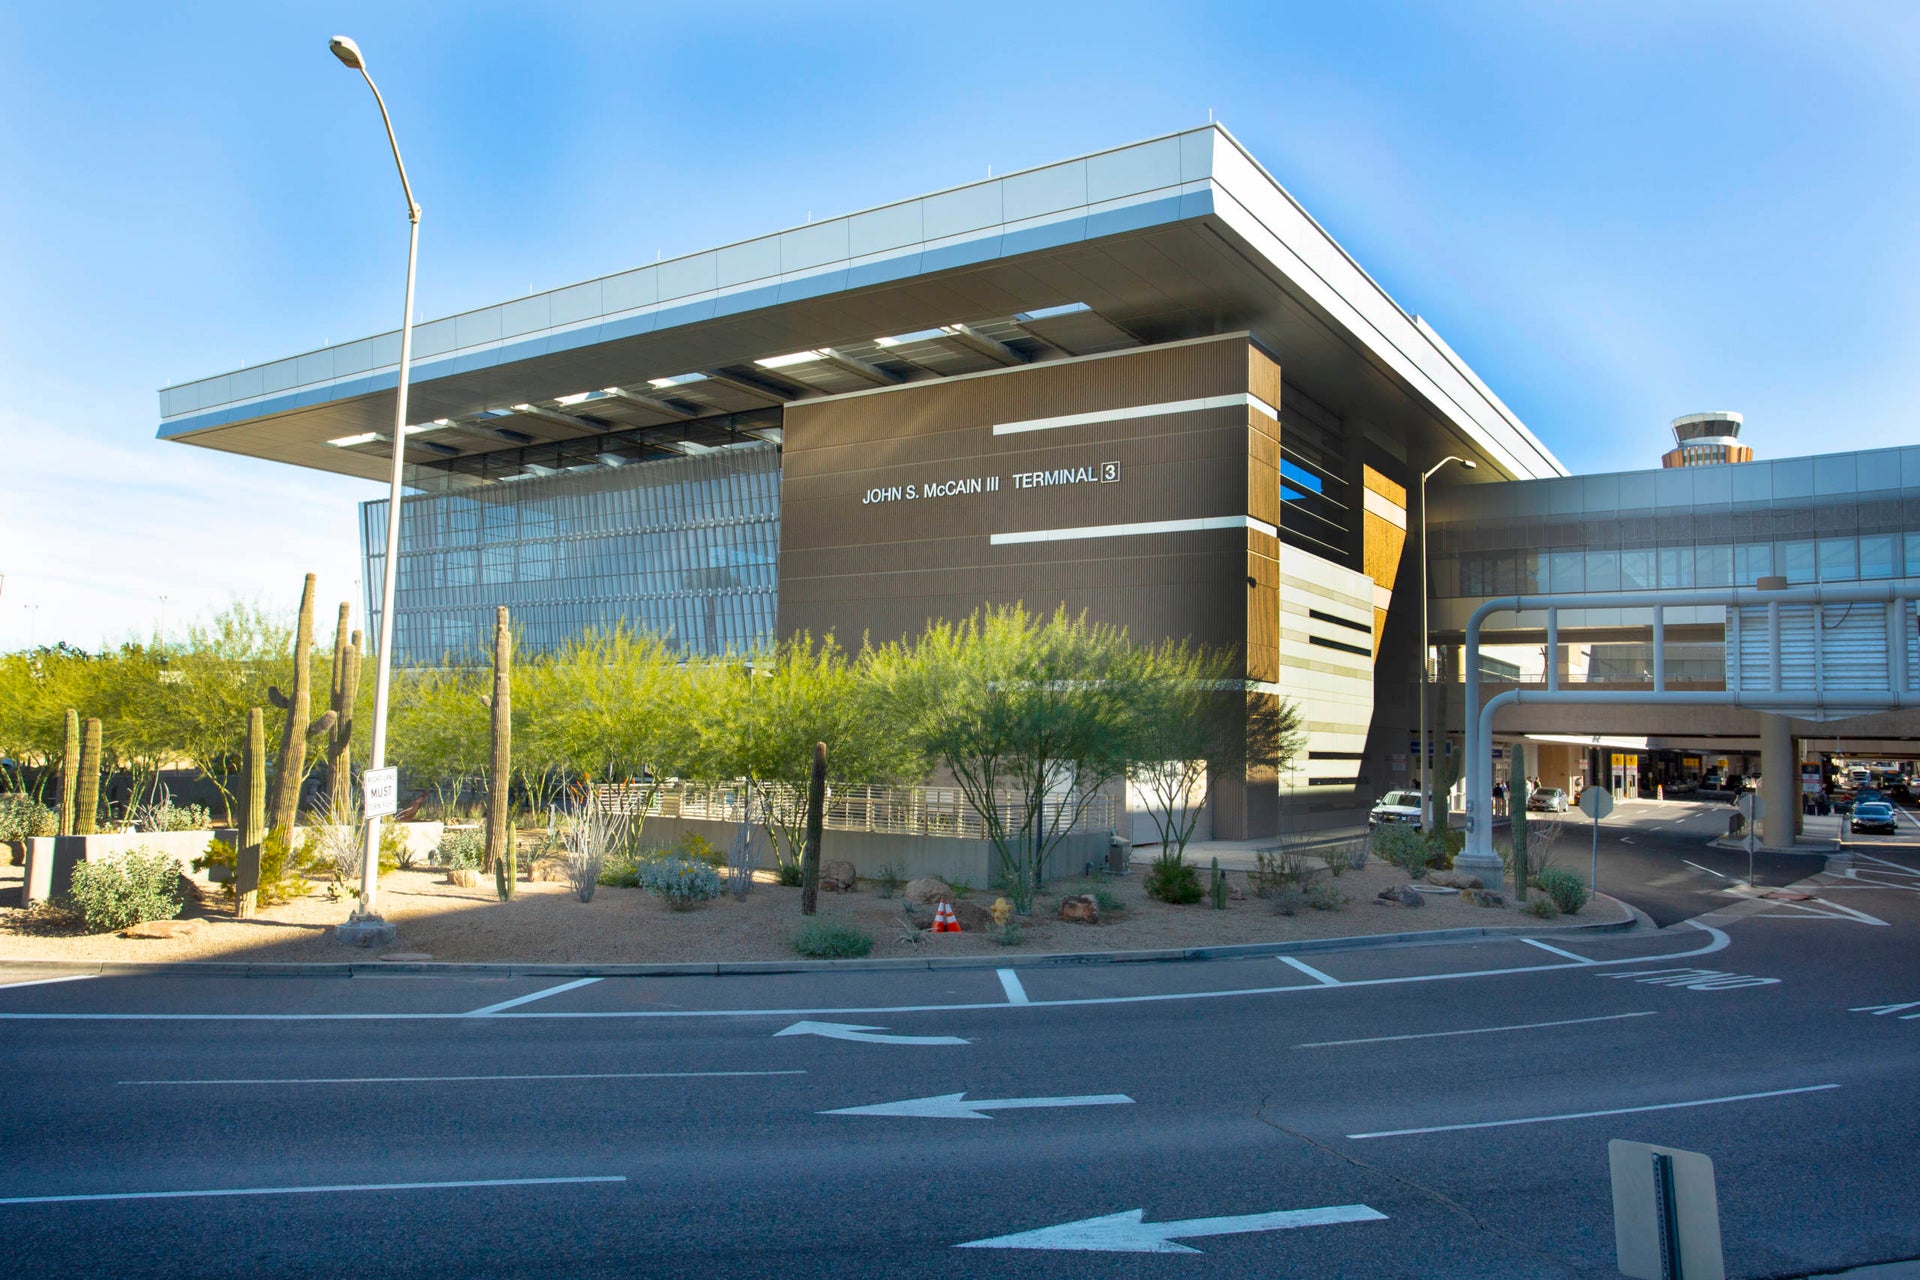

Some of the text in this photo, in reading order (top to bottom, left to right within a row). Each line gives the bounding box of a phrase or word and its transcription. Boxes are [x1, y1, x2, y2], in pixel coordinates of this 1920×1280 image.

[862, 463, 1117, 504] JOHN S. McCAIN III TERMINAL 3
[370, 785, 392, 799] MUST
